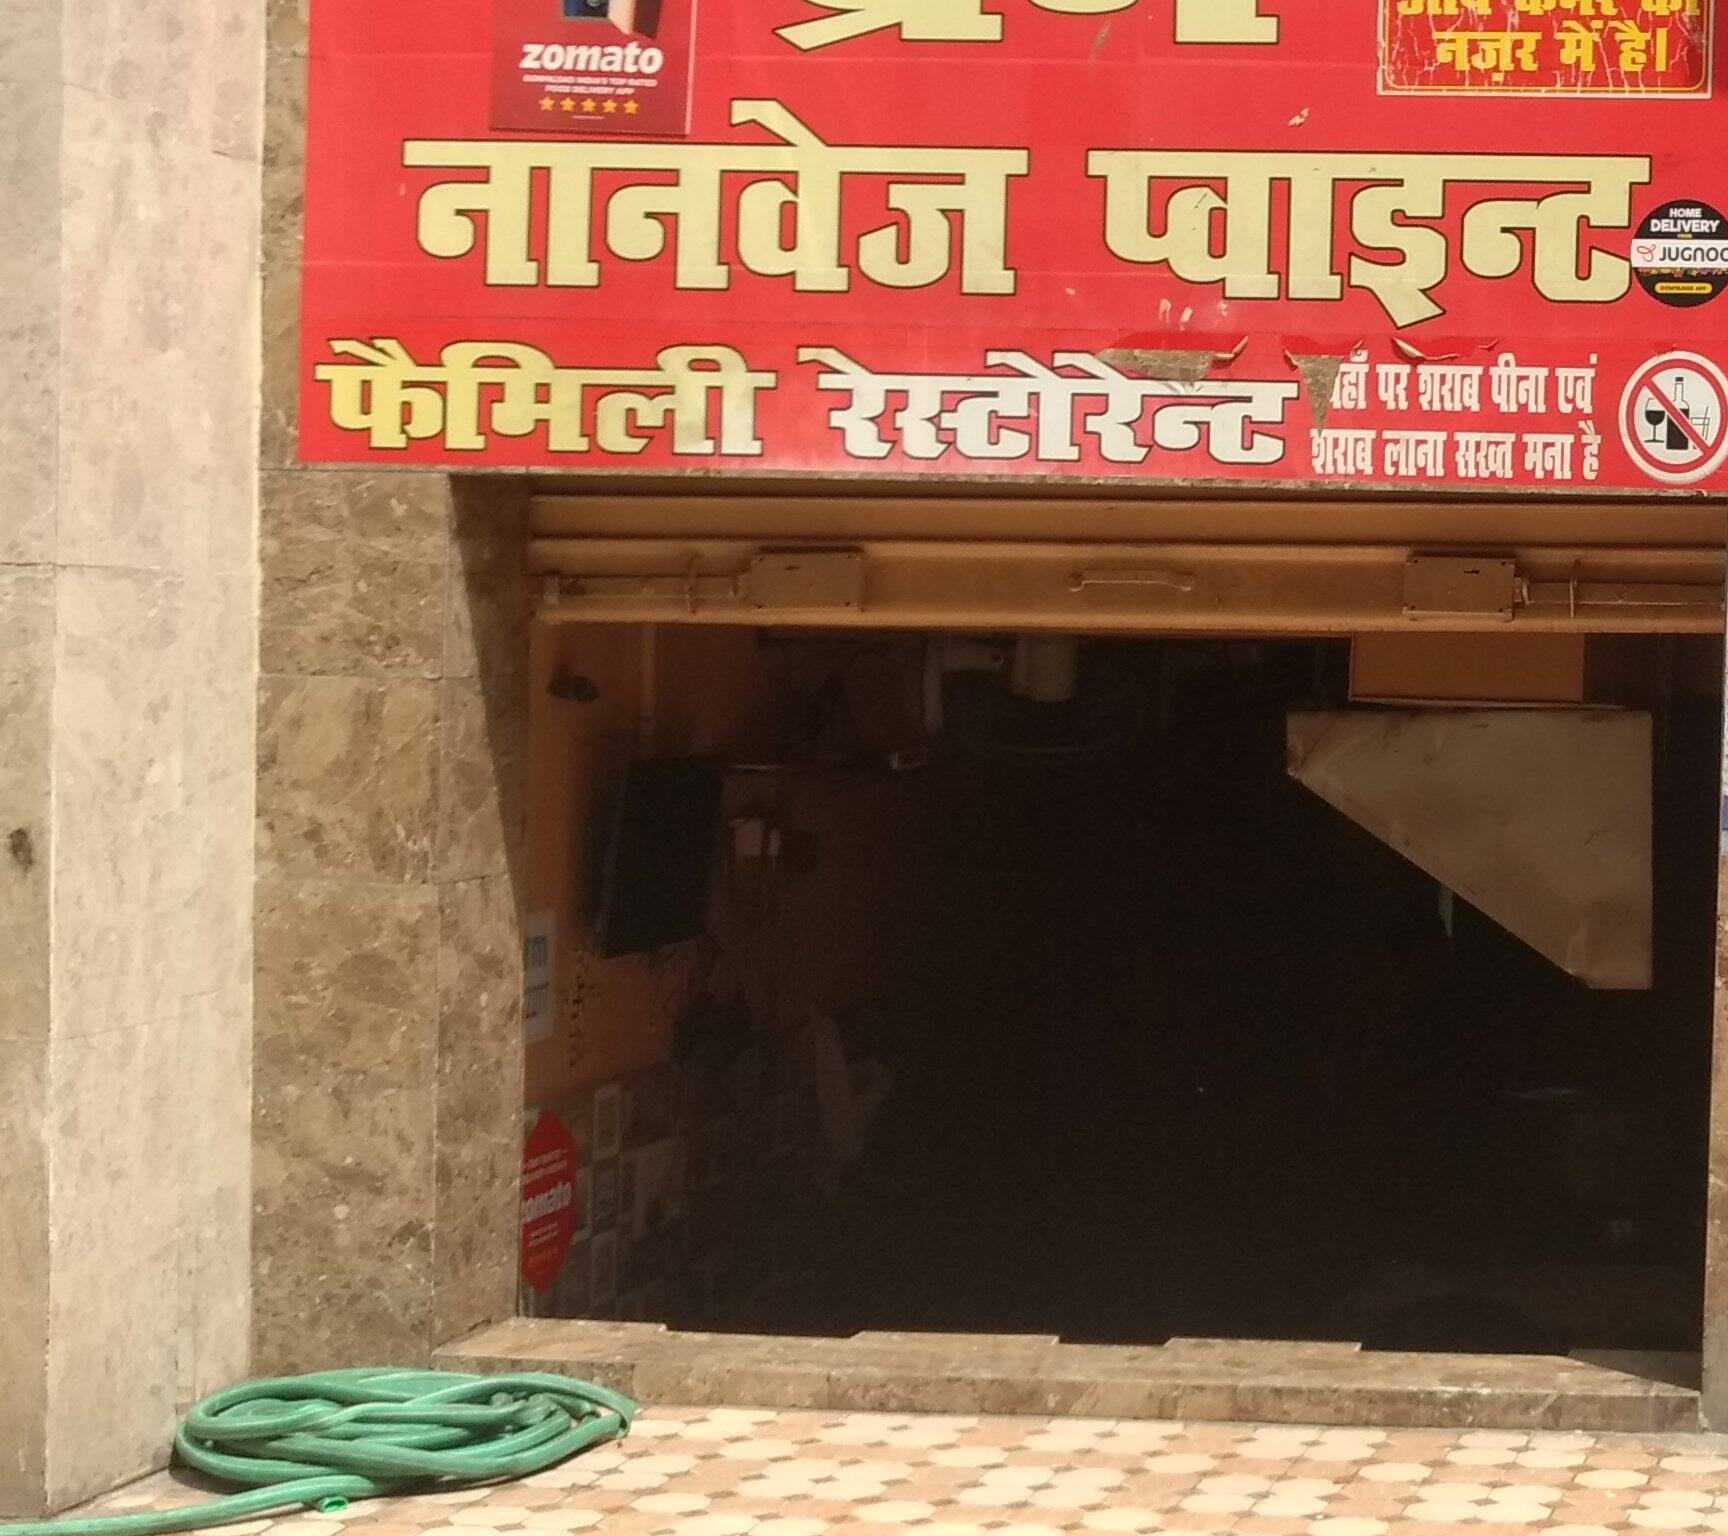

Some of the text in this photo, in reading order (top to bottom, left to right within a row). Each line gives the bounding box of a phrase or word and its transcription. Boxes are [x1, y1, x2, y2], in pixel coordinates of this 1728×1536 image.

[519, 40, 663, 74] zomato
[1555, 20, 1604, 72] में
[402, 98, 1651, 330] नानवेज प्वाइन्ट
[1650, 219, 1721, 233] DELIVERY
[1669, 207, 1703, 218] HOME
[316, 339, 1300, 465] फैमिली रेस्टोरेन्ट
[1376, 364, 1411, 411] पर
[1417, 365, 1483, 413] शराब
[1489, 352, 1549, 414] पीना
[1555, 353, 1598, 414] एवं
[1310, 419, 1602, 481] शराब लाना सख्त मना है
